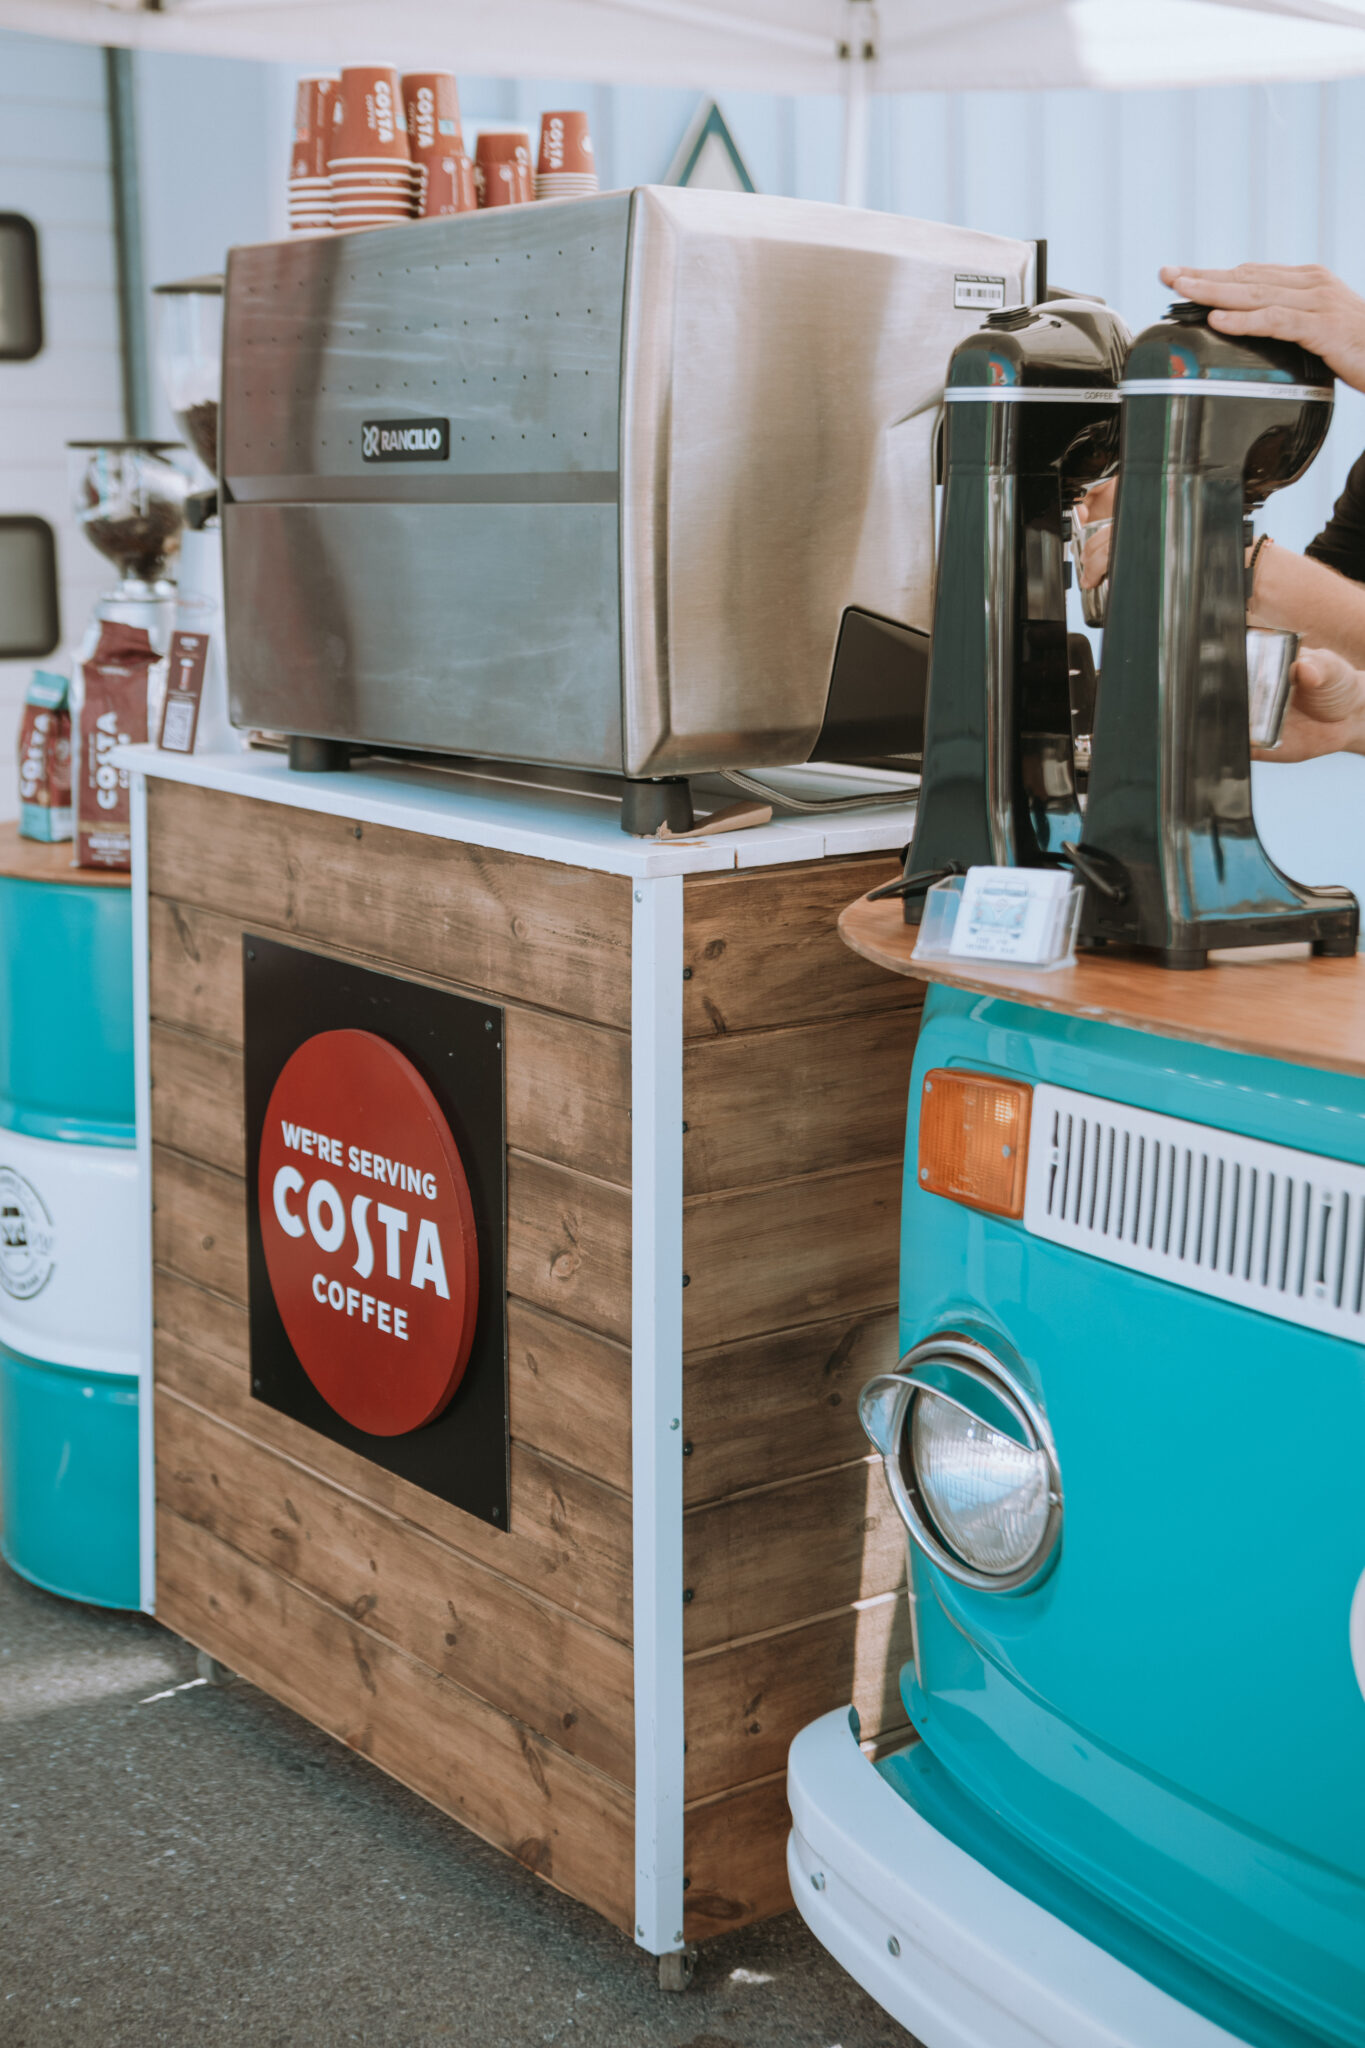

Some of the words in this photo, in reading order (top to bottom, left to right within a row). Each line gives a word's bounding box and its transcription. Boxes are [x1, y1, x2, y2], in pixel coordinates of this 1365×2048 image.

[374, 80, 395, 143] COSTA
[416, 87, 434, 147] COSTA
[549, 118, 564, 169] COSTA
[1084, 391, 1114, 400] COFFEE
[381, 427, 442, 451] RANCILIO
[281, 1120, 343, 1167] WE'RE
[348, 1146, 437, 1200] SERVING
[273, 1165, 450, 1301] COSTA
[312, 1273, 409, 1341] COFFEE
